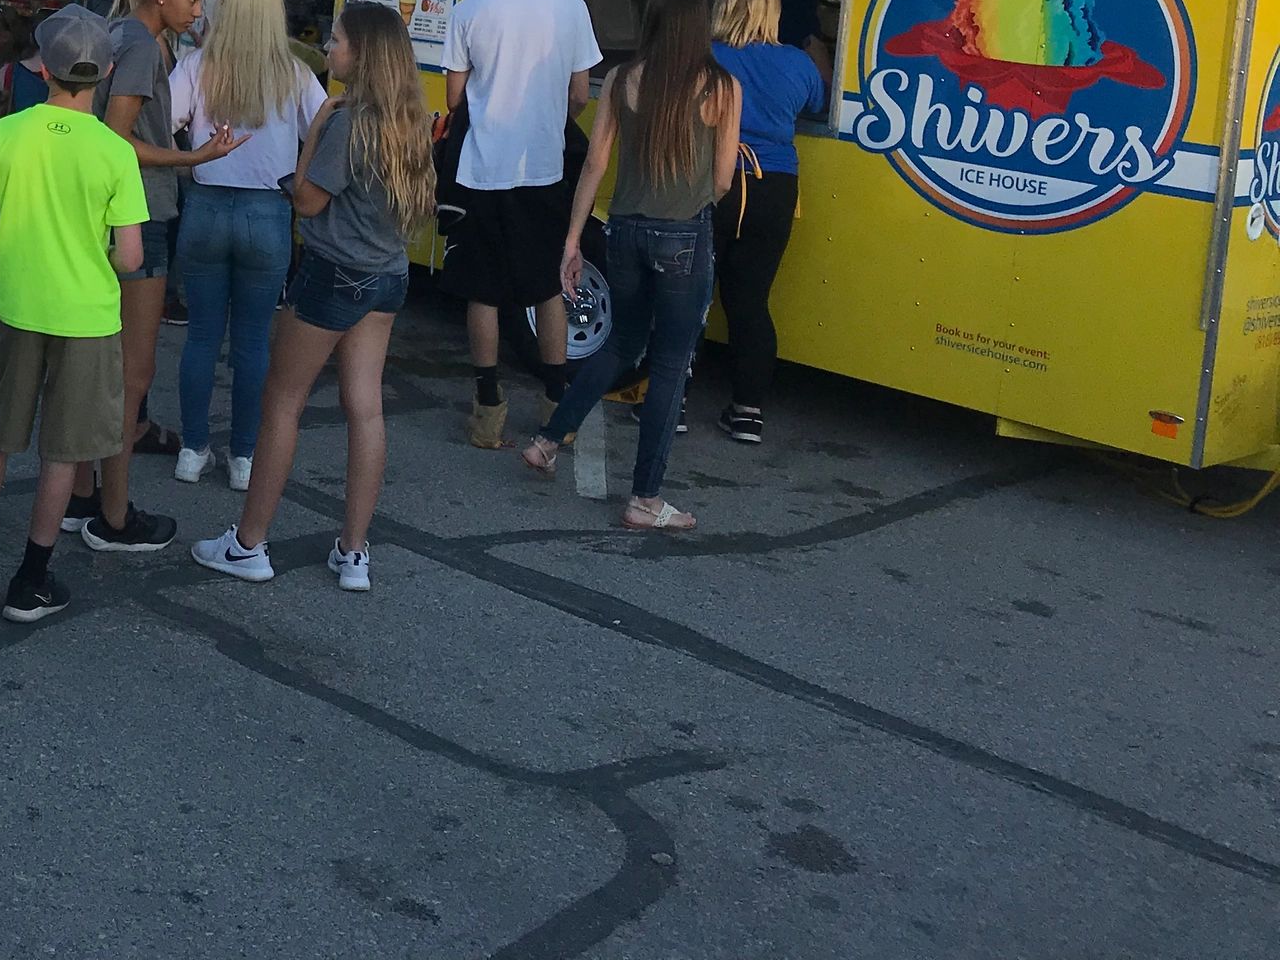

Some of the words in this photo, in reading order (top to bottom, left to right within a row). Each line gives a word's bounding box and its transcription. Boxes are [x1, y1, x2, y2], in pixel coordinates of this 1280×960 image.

[856, 69, 1170, 183] Shivers
[959, 166, 986, 185] ICE
[989, 172, 1048, 196] HOUSE
[935, 323, 961, 337] Book
[963, 331, 973, 341] us
[977, 333, 991, 345] for
[993, 340, 1018, 352] your
[1019, 346, 1051, 360] event:
[935, 335, 1048, 372] shiversicehouse.com
